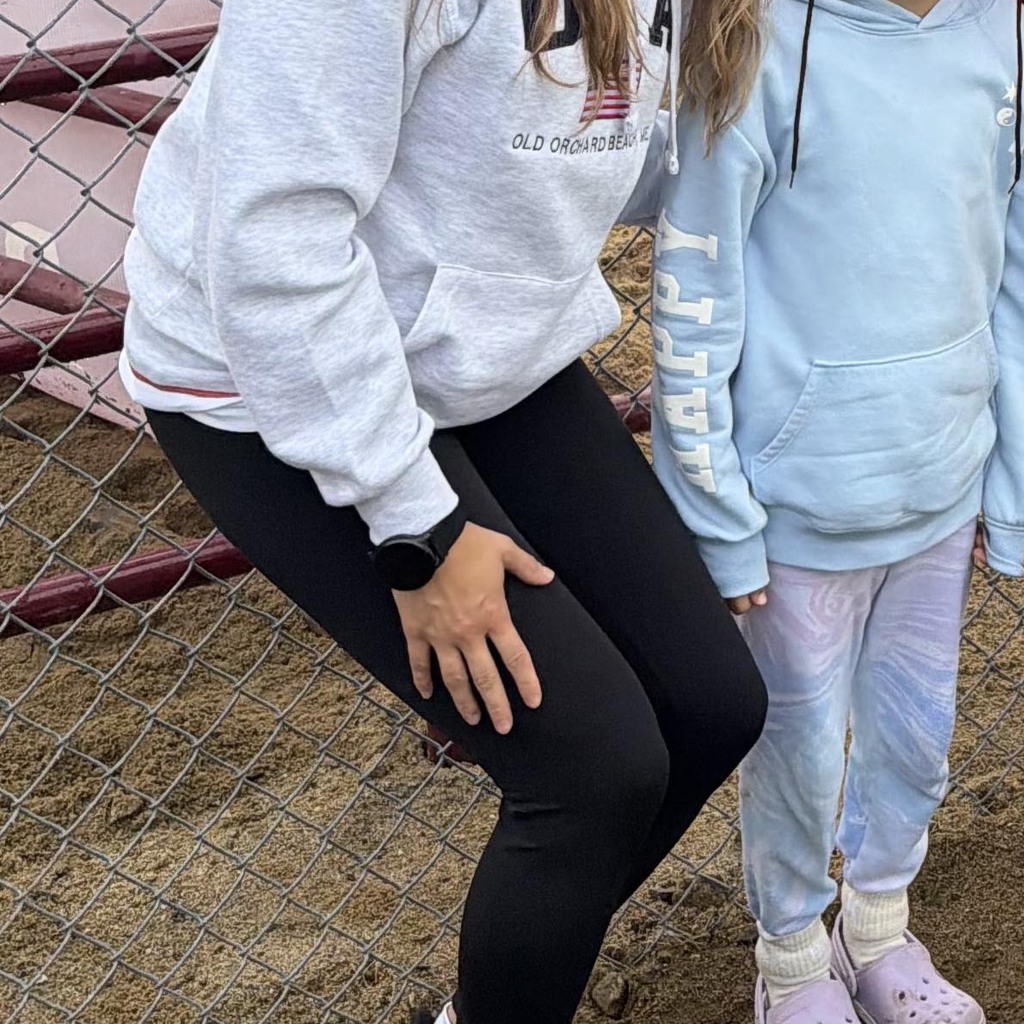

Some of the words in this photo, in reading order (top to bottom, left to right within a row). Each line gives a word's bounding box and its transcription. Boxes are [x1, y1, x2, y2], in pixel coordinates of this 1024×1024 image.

[512, 133, 544, 151] OLD
[550, 135, 606, 155] ORCHARD
[651, 208, 718, 494] HAPPY
